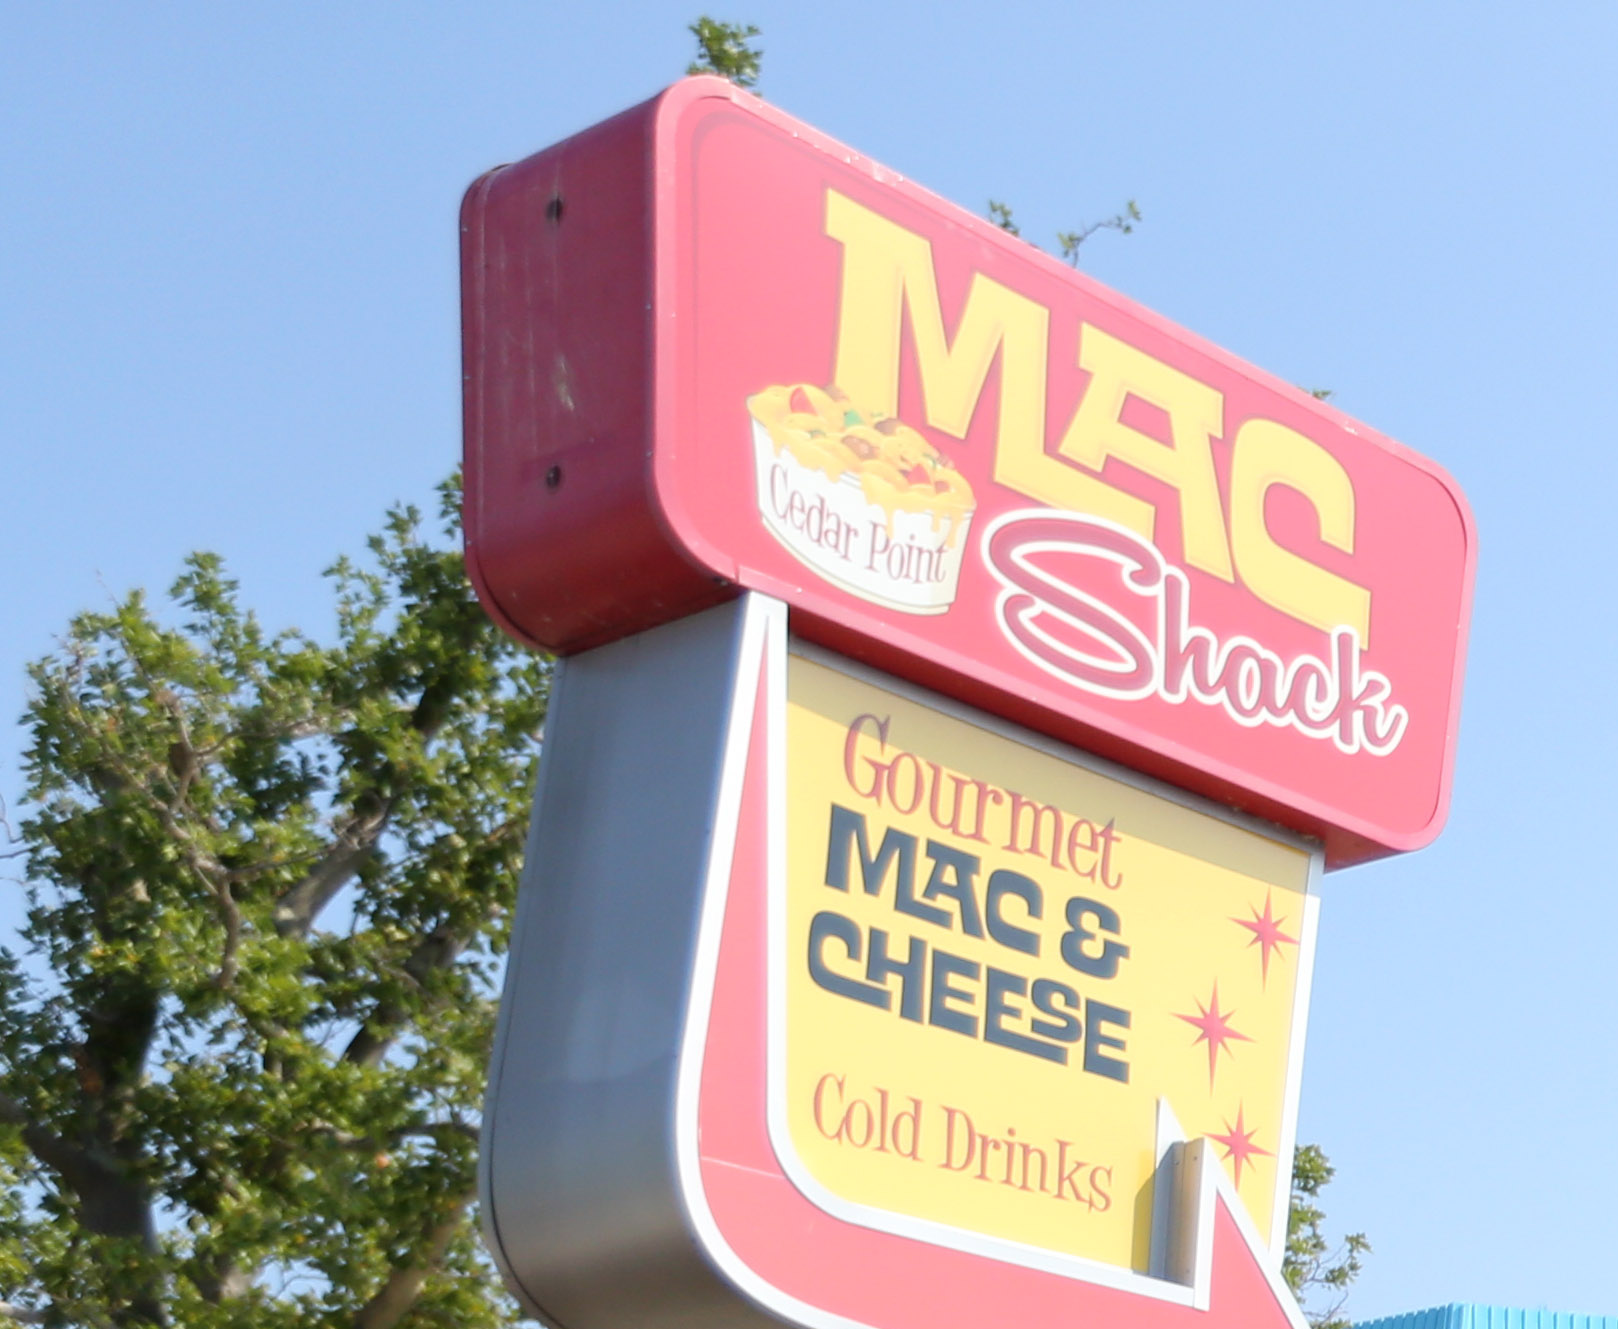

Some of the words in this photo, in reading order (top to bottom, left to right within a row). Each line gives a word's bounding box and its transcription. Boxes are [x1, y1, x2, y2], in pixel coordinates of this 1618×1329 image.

[825, 188, 1372, 650] MAC
[770, 463, 859, 562] Cedar
[865, 520, 948, 584] Point
[983, 507, 1408, 755] Shack
[843, 713, 1123, 890] Gourmet
[824, 802, 1043, 957] MAC
[1059, 896, 1131, 980] &
[807, 910, 1132, 1085] CHEESE
[812, 1072, 925, 1163] Cold
[937, 1104, 1115, 1214] Drinks
